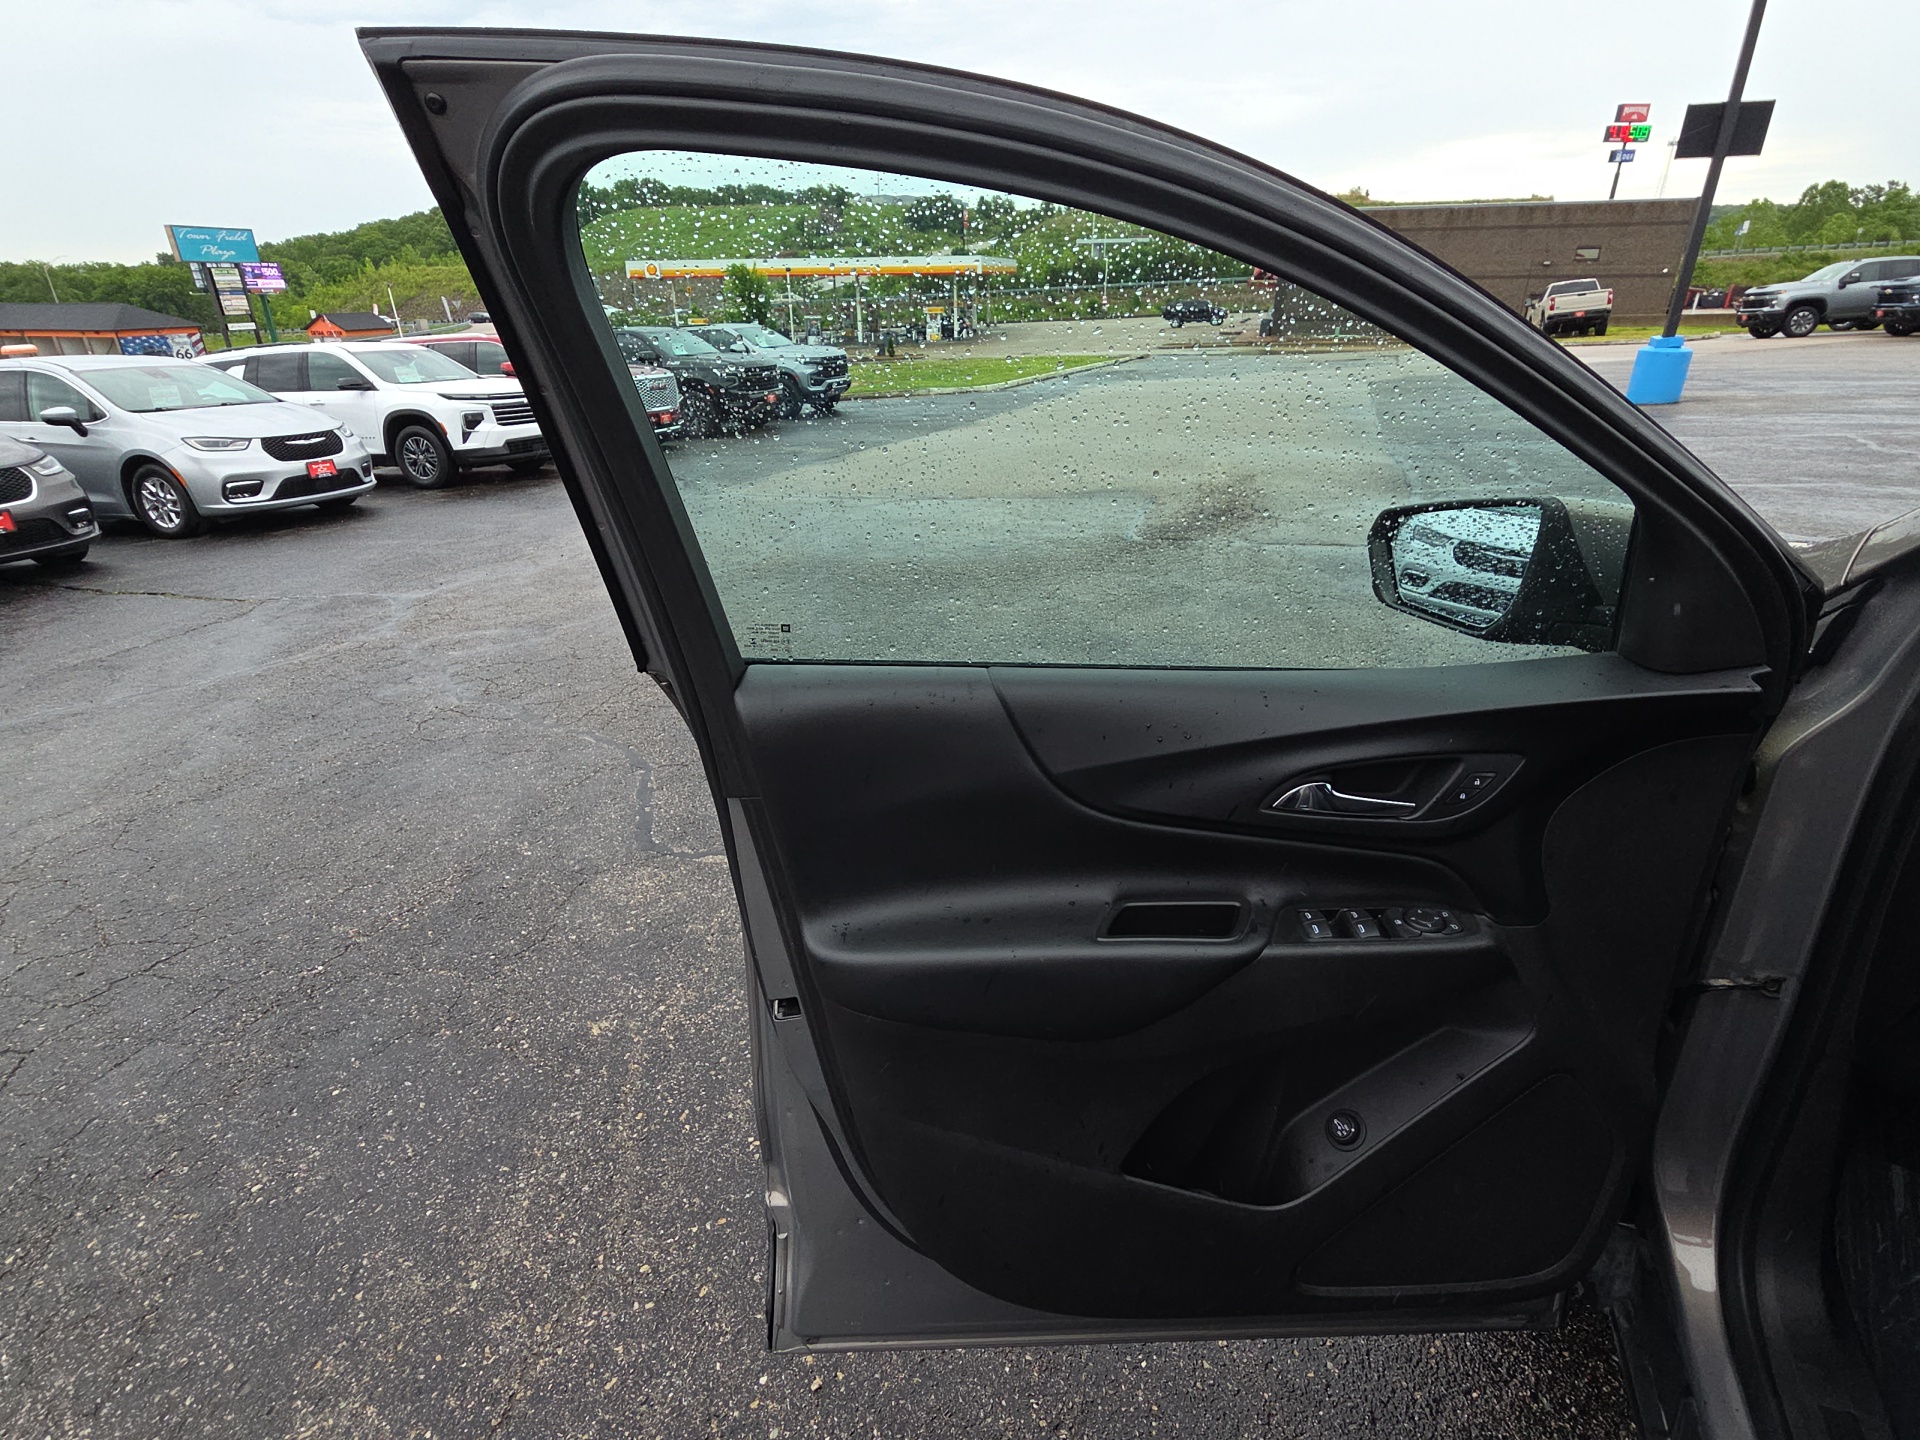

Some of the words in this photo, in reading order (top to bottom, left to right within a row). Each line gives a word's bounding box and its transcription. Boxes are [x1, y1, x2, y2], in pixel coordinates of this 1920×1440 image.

[179, 229, 210, 239] Town
[216, 230, 247, 241] Field
[176, 349, 193, 359] 66
